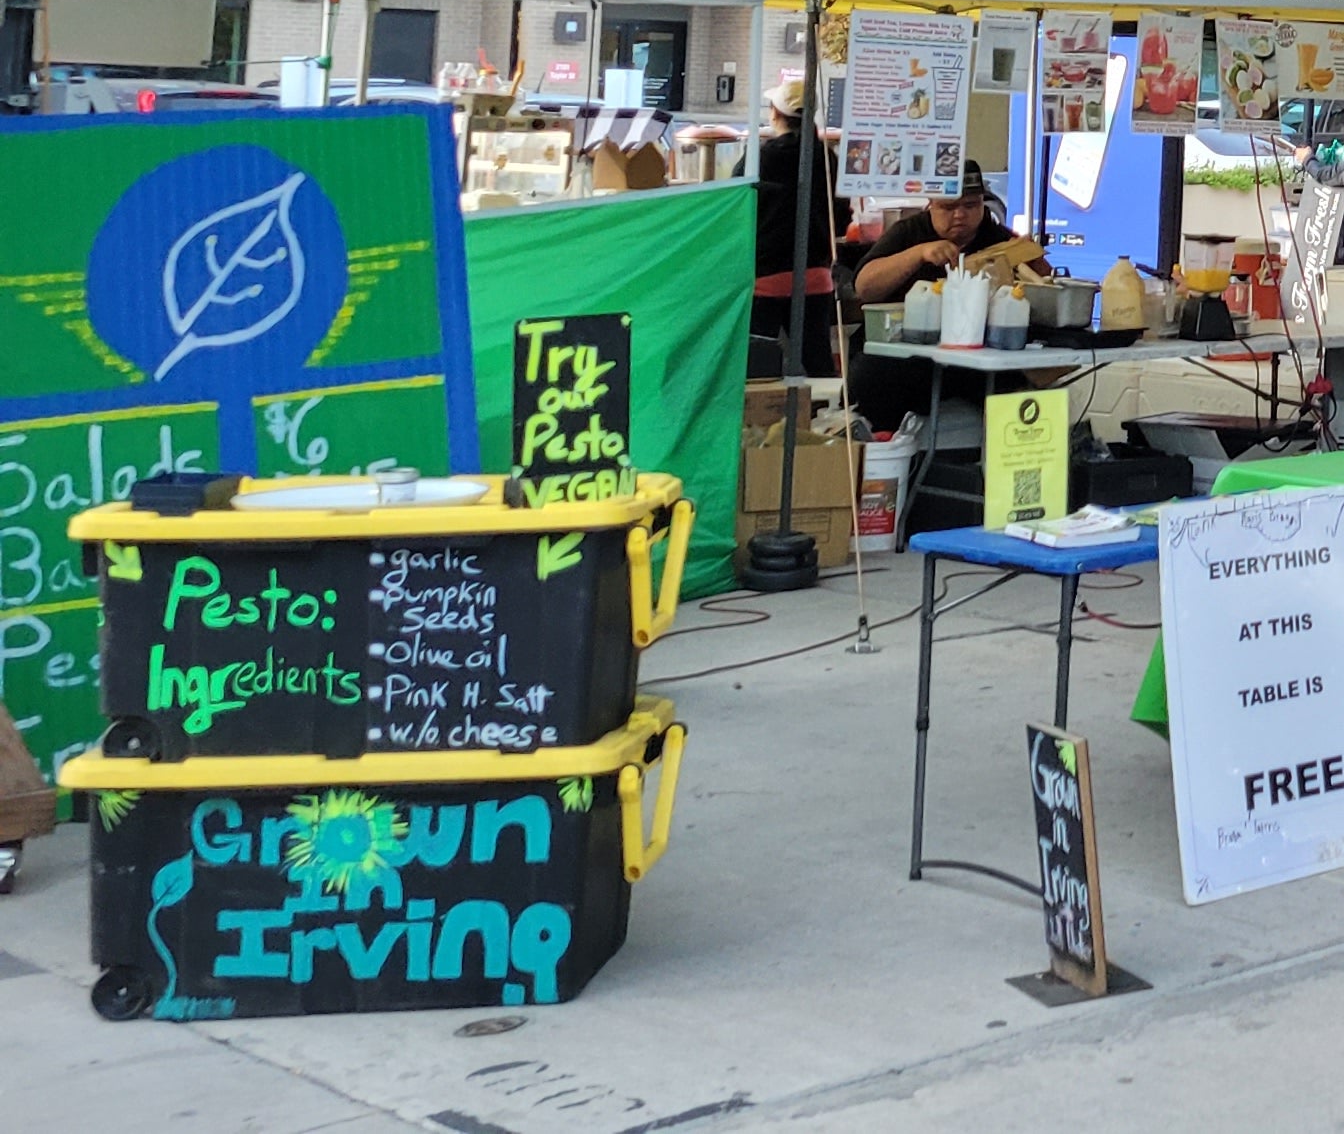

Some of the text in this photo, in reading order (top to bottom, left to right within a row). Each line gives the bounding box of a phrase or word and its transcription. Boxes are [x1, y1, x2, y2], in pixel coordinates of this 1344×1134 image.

[519, 320, 616, 392] Try
[538, 383, 609, 415] our
[521, 413, 625, 467] Pesto
[522, 468, 637, 509] VEGAN
[381, 548, 484, 588] garlic
[1209, 547, 1331, 580] EVERYTHING
[163, 556, 338, 632] Pesto:
[401, 605, 495, 634] Seeds
[1239, 613, 1313, 642] AT THIS
[385, 632, 507, 678] Olive oil
[147, 644, 362, 734] Ingredients
[385, 674, 449, 713] Pink
[1238, 676, 1323, 707] TABLE IS
[448, 714, 558, 747] cheese
[1030, 732, 1081, 821] Grown
[191, 795, 552, 866] Grown
[1053, 812, 1071, 853] in
[1039, 836, 1090, 931] Irving
[213, 899, 572, 1005] Irving
